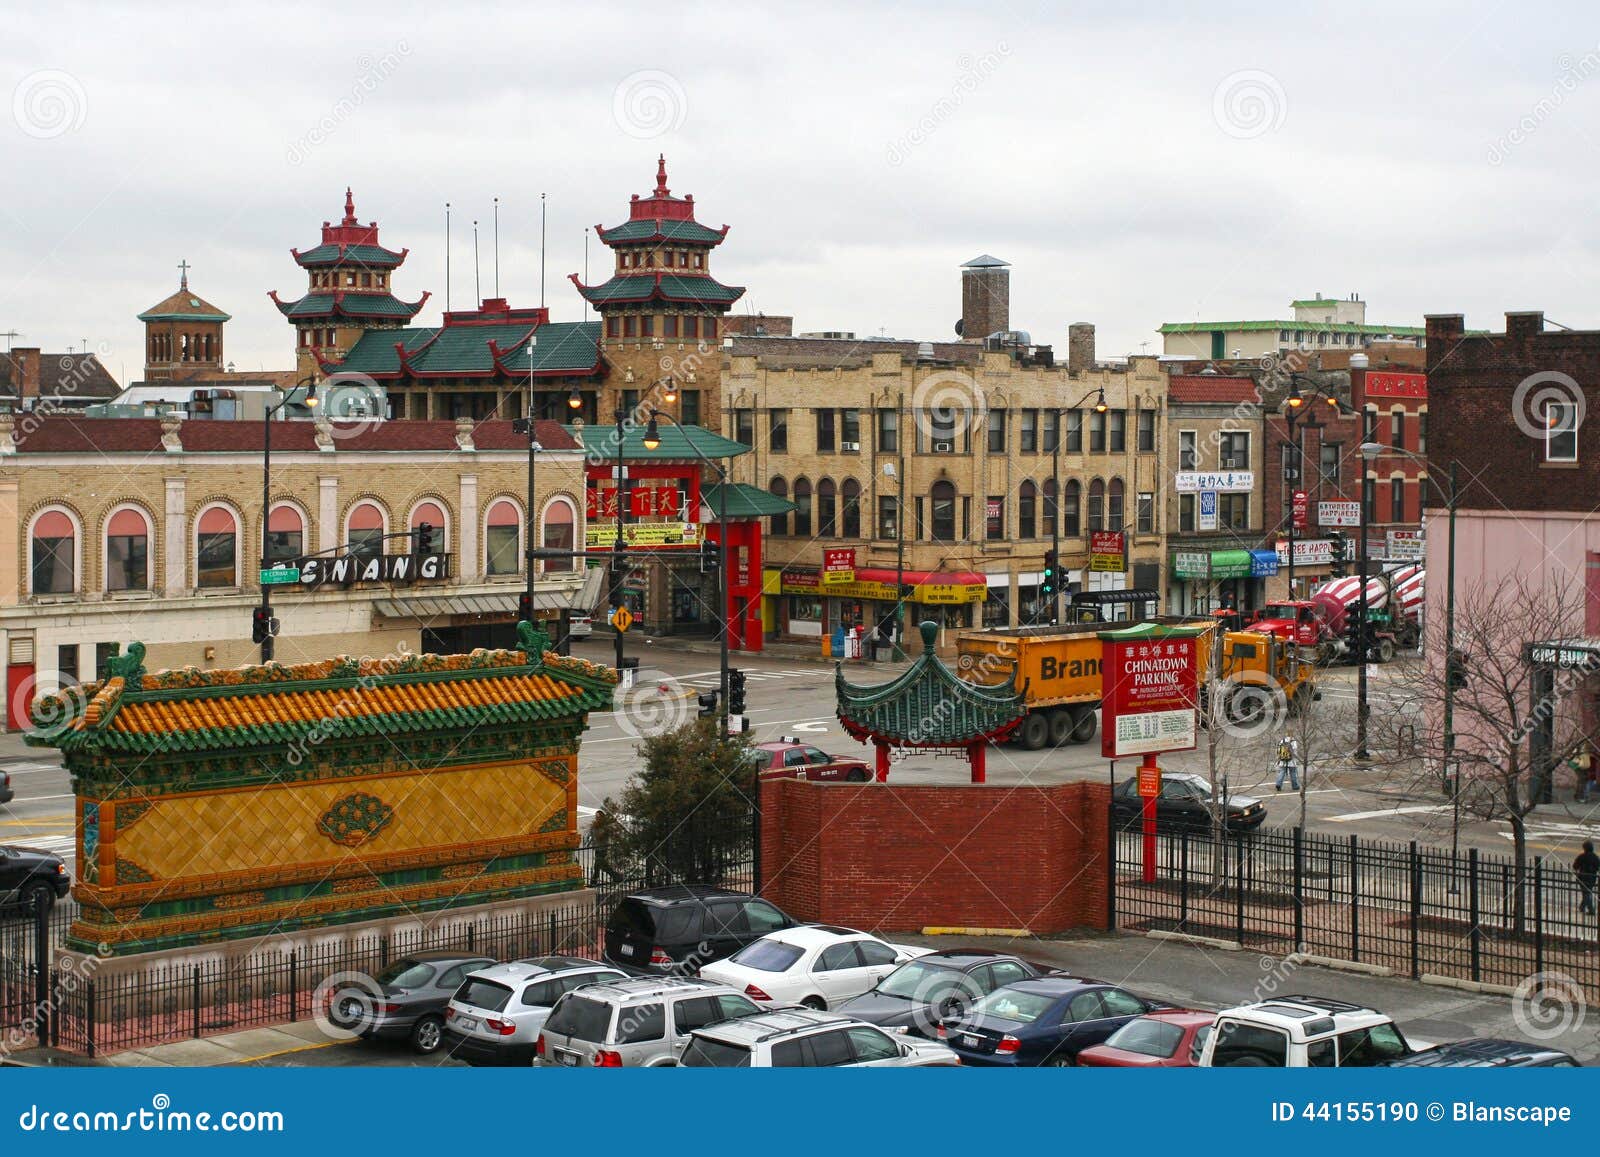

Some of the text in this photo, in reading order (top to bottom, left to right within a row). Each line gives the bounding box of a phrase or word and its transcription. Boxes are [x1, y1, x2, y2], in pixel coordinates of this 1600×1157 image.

[272, 556, 439, 582] ENANG
[1125, 658, 1188, 674] CHINATOWN
[1135, 671, 1179, 686] PARKING
